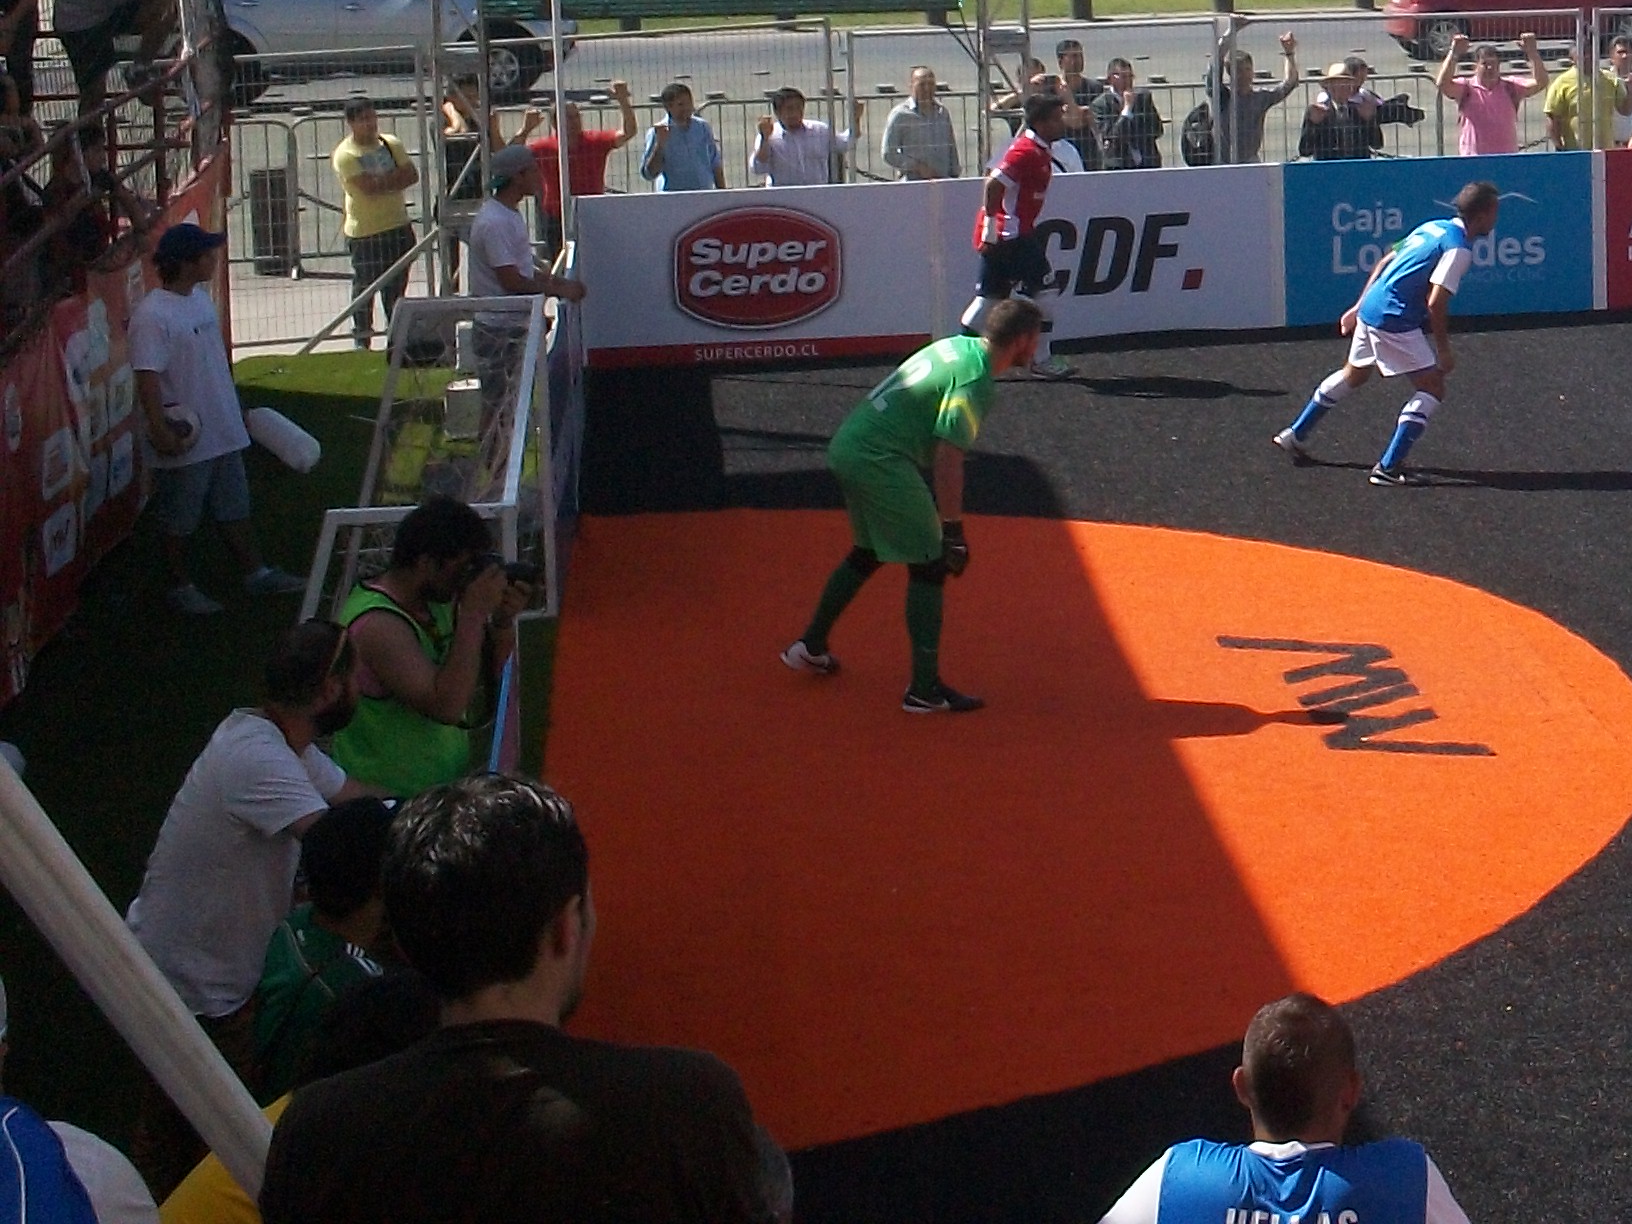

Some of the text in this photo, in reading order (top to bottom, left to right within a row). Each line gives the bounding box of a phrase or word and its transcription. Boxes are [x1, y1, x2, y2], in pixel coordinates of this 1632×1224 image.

[1332, 201, 1403, 239] Caja
[689, 235, 827, 268] Super
[1333, 235, 1392, 274] Lo
[688, 267, 827, 299] Cerdo
[694, 342, 820, 362] SUPERCERDO.CL
